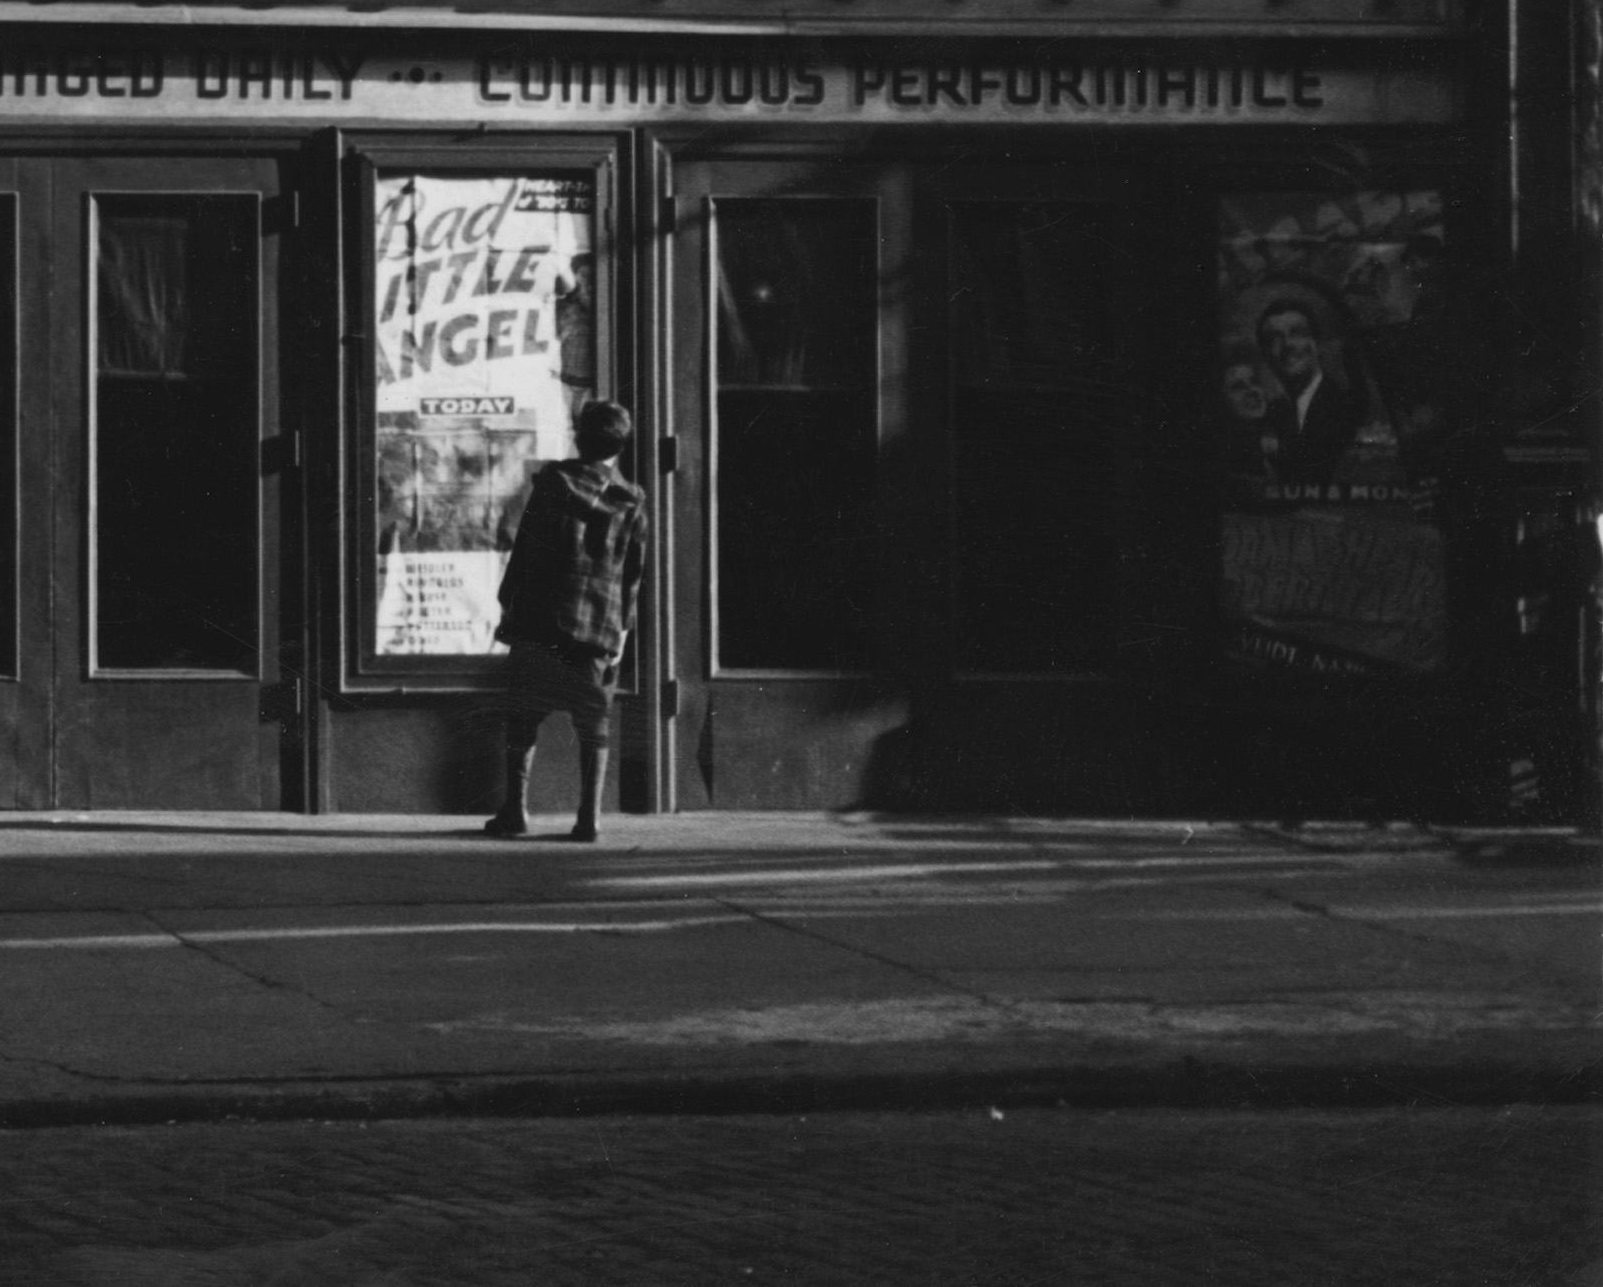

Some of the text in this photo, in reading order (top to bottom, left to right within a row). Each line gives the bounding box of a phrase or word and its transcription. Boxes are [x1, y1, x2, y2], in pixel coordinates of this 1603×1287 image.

[197, 45, 368, 101] DAILY
[478, 53, 1325, 110] CONTINUOUS PERFORMANCE
[378, 179, 519, 265] Bad
[380, 244, 550, 324] ITTLE
[421, 397, 513, 415] TODAY
